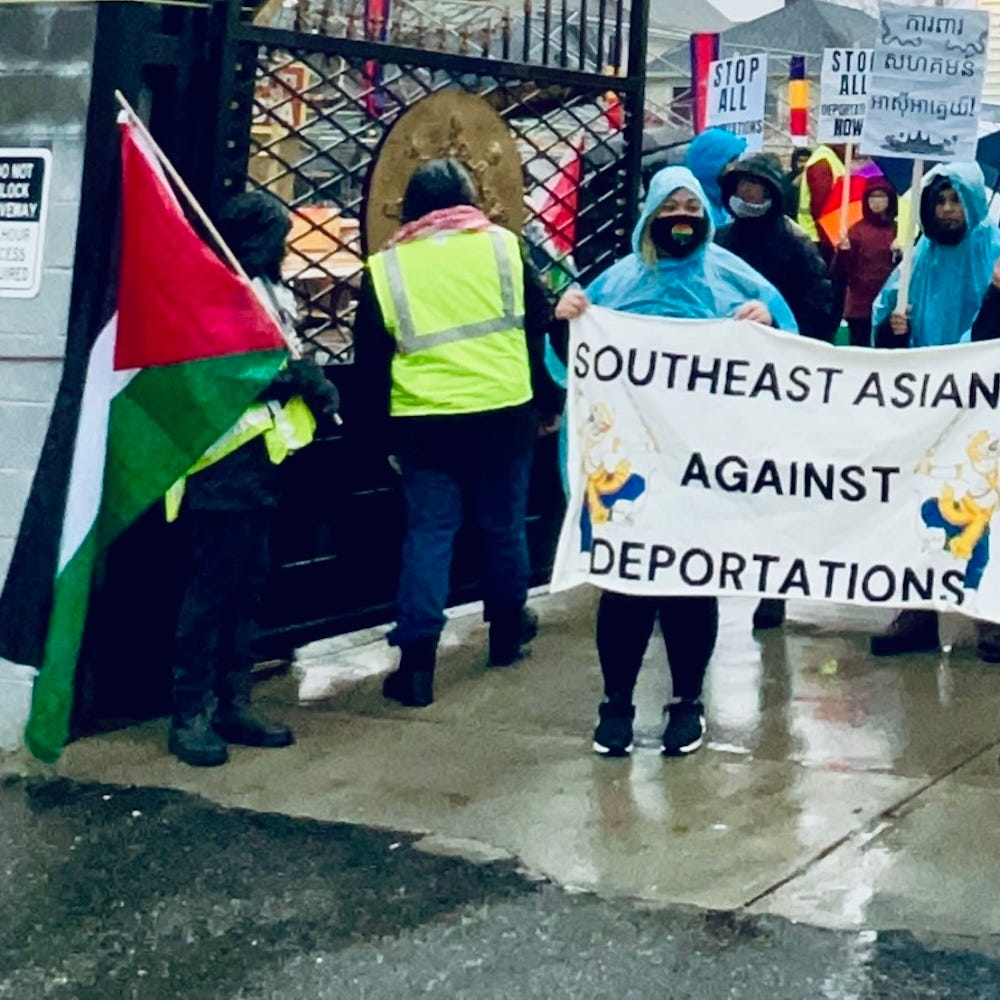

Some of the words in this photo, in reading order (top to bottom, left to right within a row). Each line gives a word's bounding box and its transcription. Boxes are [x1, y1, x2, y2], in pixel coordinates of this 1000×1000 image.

[714, 57, 759, 88] STOP
[840, 74, 867, 96] ALL
[718, 85, 747, 113] ALL
[0, 182, 31, 199] LOCK
[574, 342, 843, 404] SOUTHEAST
[680, 452, 900, 503] AGAINST
[589, 537, 966, 607] DEPORTATIONS
